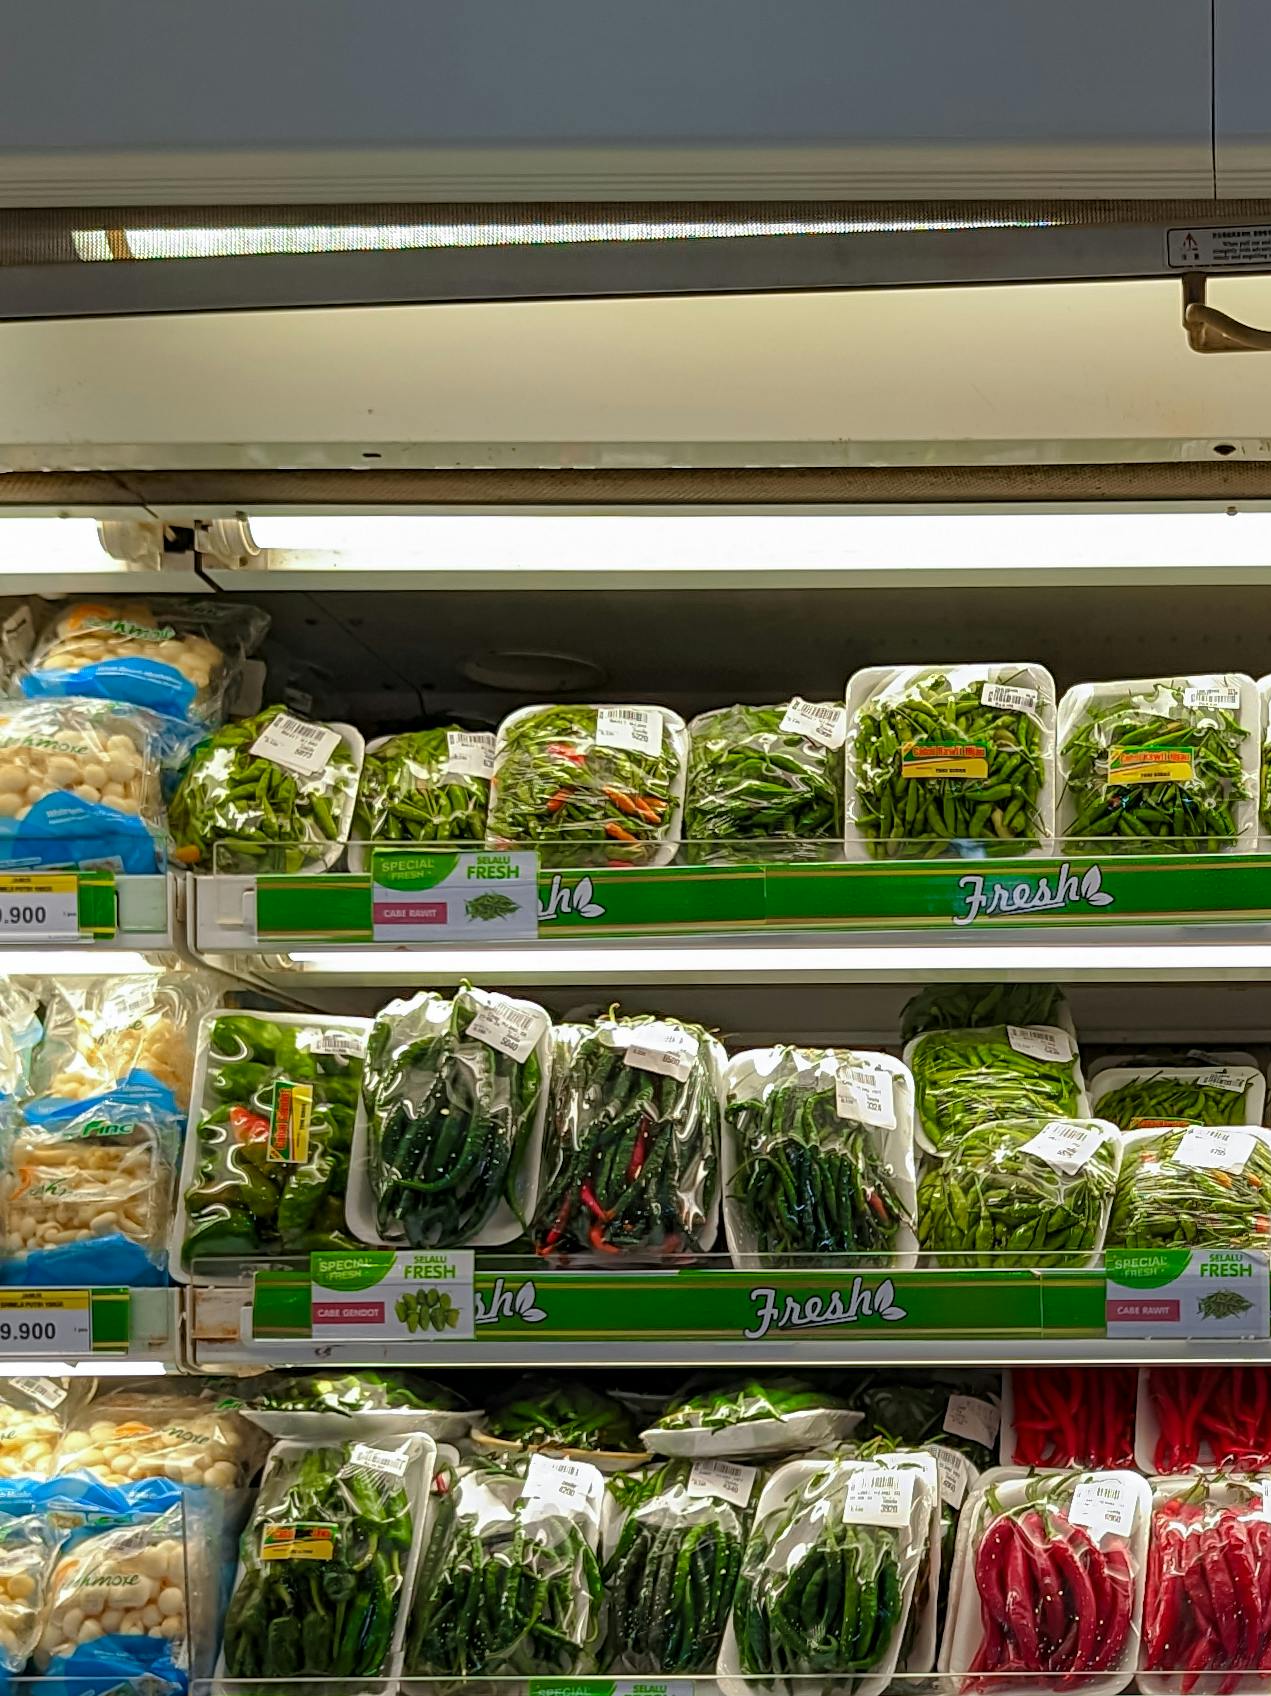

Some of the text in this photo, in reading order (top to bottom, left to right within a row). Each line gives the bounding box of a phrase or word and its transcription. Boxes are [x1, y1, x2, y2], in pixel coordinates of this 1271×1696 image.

[382, 858, 435, 873] SPECIAL
[476, 856, 510, 866] SELALU
[466, 864, 520, 880] FRESH
[953, 863, 1081, 925] Fresh
[0, 906, 46, 924] .900
[383, 907, 437, 919] CABE RAWIT
[413, 1255, 448, 1265] SELALU
[1114, 1256, 1168, 1271] SPECIAL
[1208, 1253, 1244, 1263] SELALU
[319, 1258, 373, 1274] SPECIAL
[404, 1264, 456, 1279] FRESH
[1199, 1262, 1253, 1278] FRESH
[317, 1307, 381, 1319] CABE GENDOT
[744, 1277, 877, 1338] Fresh
[1116, 1305, 1171, 1316] CABE RAWIT
[632, 1684, 668, 1695] SELALU
